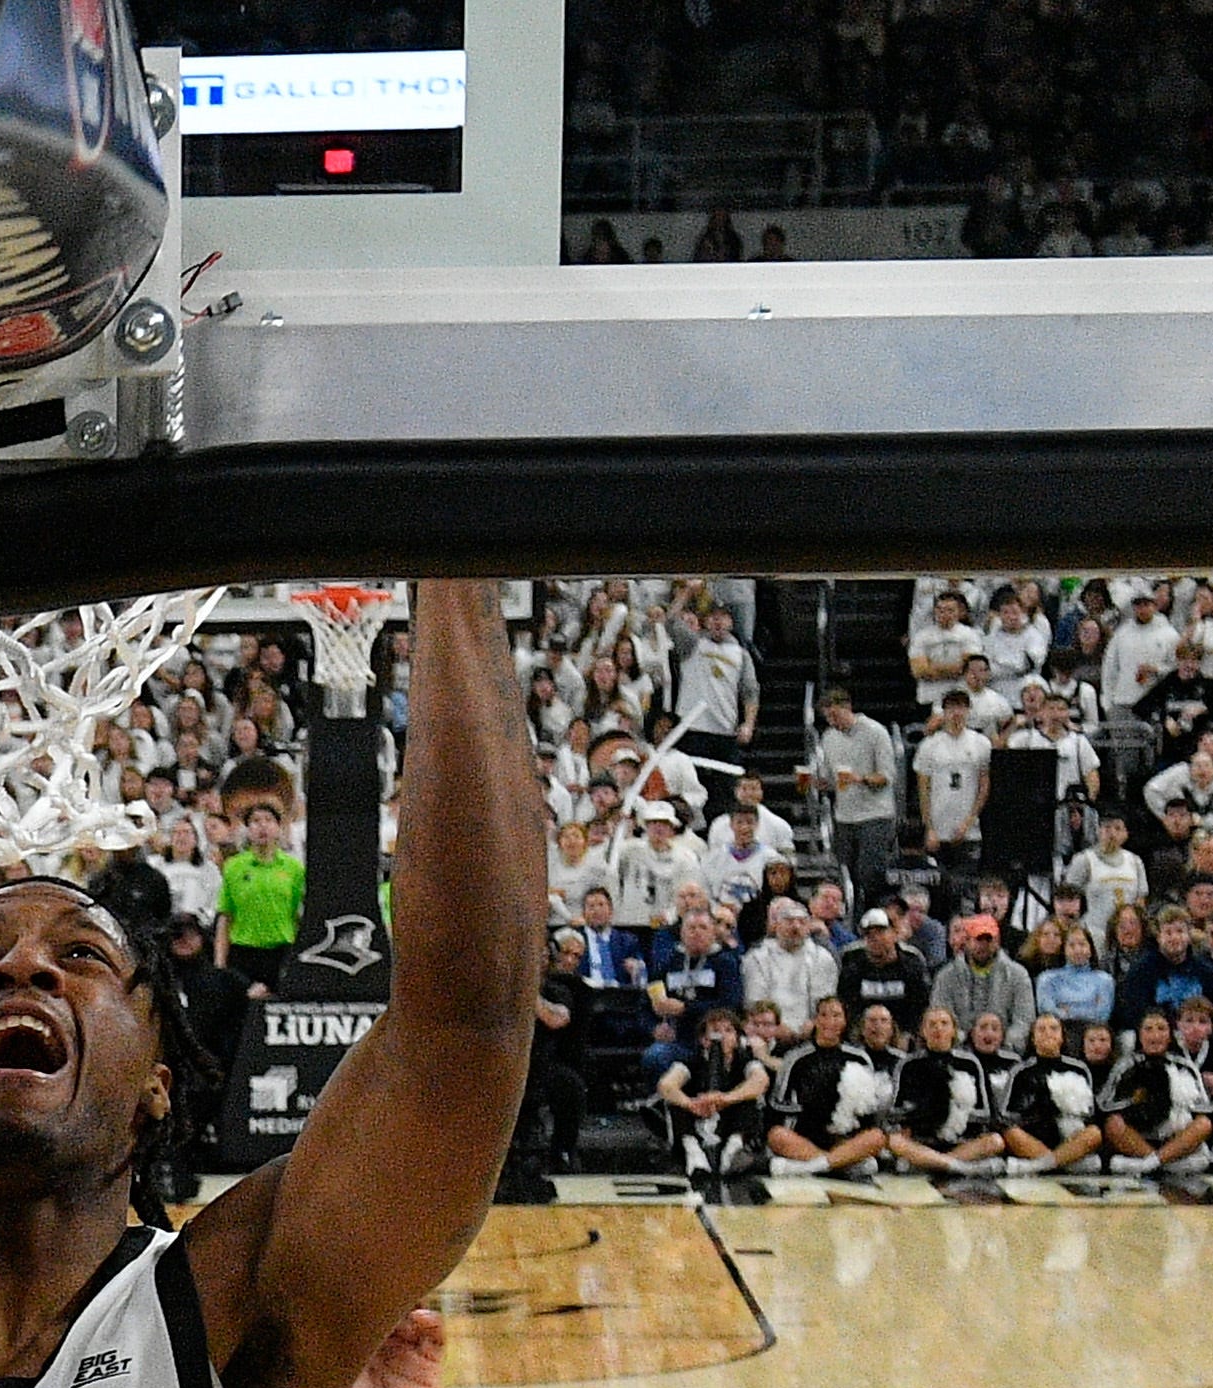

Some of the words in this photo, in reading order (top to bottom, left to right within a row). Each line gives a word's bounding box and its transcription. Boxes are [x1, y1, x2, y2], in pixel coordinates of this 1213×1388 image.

[234, 79, 356, 100] GALLO
[72, 1357, 133, 1384] EAST
[78, 1350, 118, 1372] BIG
